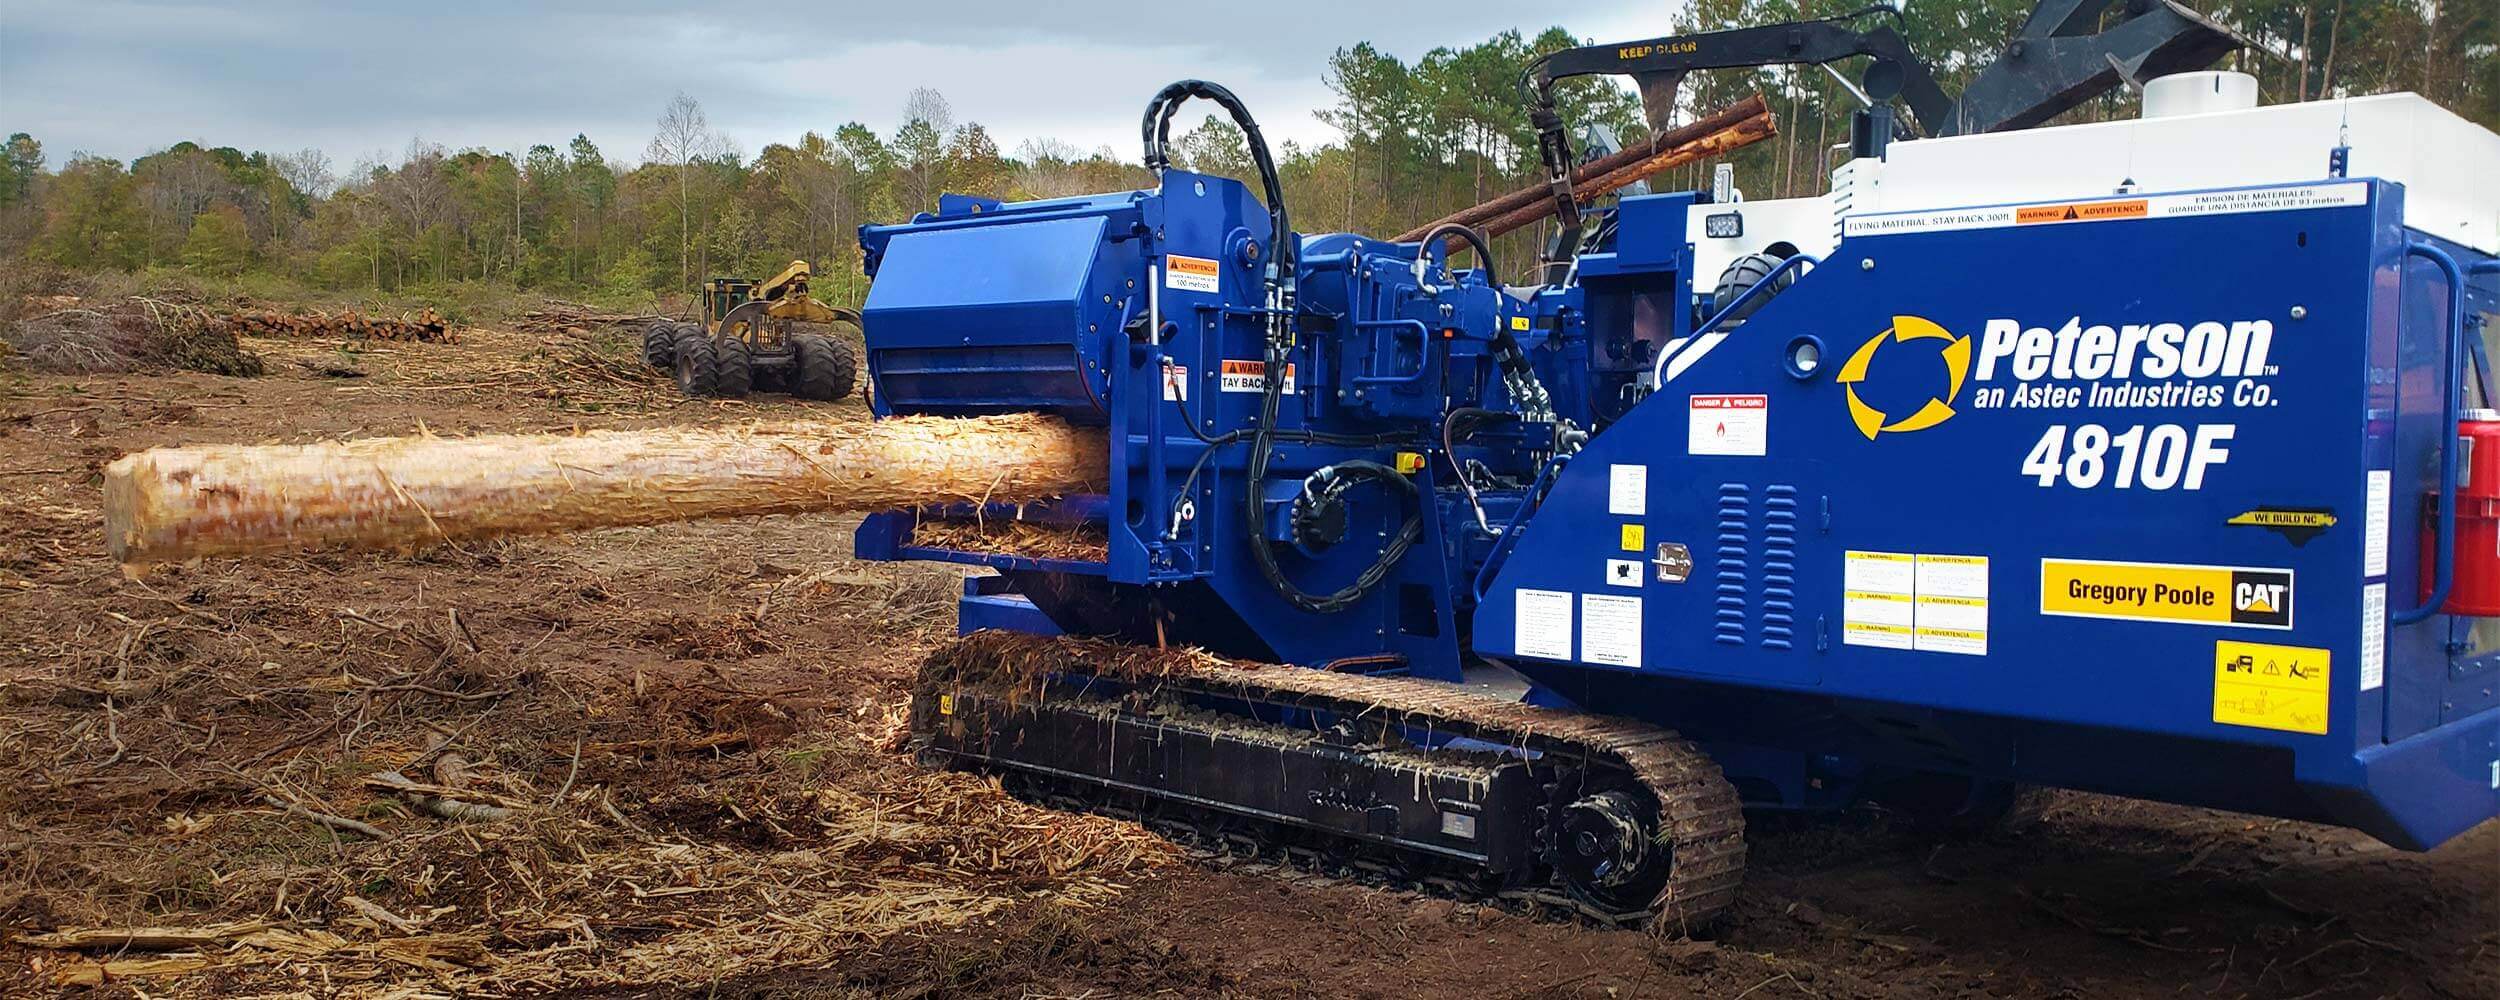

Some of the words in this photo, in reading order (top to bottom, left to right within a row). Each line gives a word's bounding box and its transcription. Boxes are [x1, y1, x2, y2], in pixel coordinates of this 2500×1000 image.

[1619, 46, 1652, 60] KEEP
[1656, 41, 1697, 54] CLEAN
[2019, 210, 2060, 220] WARNING
[2083, 204, 2145, 216] ADVERTENCIA
[1932, 215, 1956, 226] STAY
[1957, 213, 1985, 224] BACK
[1180, 262, 1217, 273] ADVERTENCIA
[1975, 316, 2273, 381] Peterson
[1239, 362, 1266, 375] WARN
[1973, 387, 2005, 408] an
[2009, 382, 2082, 408] Astec
[2087, 380, 2224, 408] Industries
[2232, 378, 2279, 408] Co.
[1694, 399, 1721, 408] DANGER
[1733, 399, 1764, 408] PELIGRO
[2021, 423, 2236, 490] 4810F
[2254, 513, 2268, 523] WE
[2273, 513, 2301, 524] BUILD
[2303, 514, 2317, 524] NC
[2068, 578, 2148, 607] Gregory
[2154, 582, 2215, 607] Poole
[2236, 582, 2284, 613] CAT
